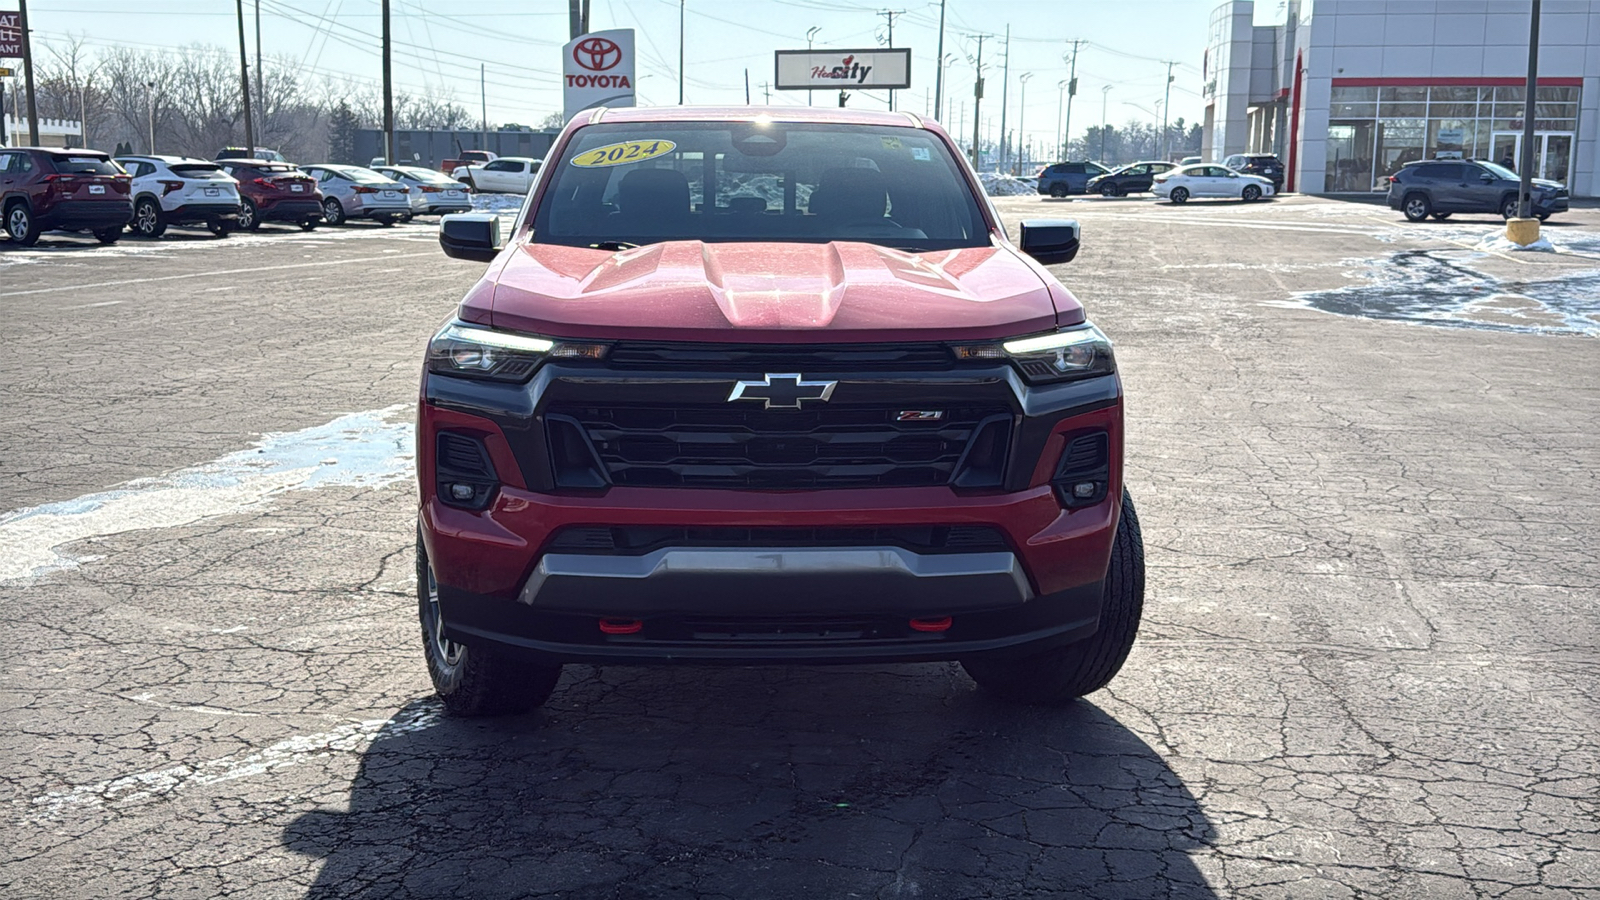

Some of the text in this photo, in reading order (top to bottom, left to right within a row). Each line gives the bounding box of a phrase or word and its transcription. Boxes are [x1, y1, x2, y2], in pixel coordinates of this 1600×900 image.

[565, 75, 631, 88] TOYOTA
[590, 141, 660, 165] 2024
[897, 410, 943, 420] Z71
